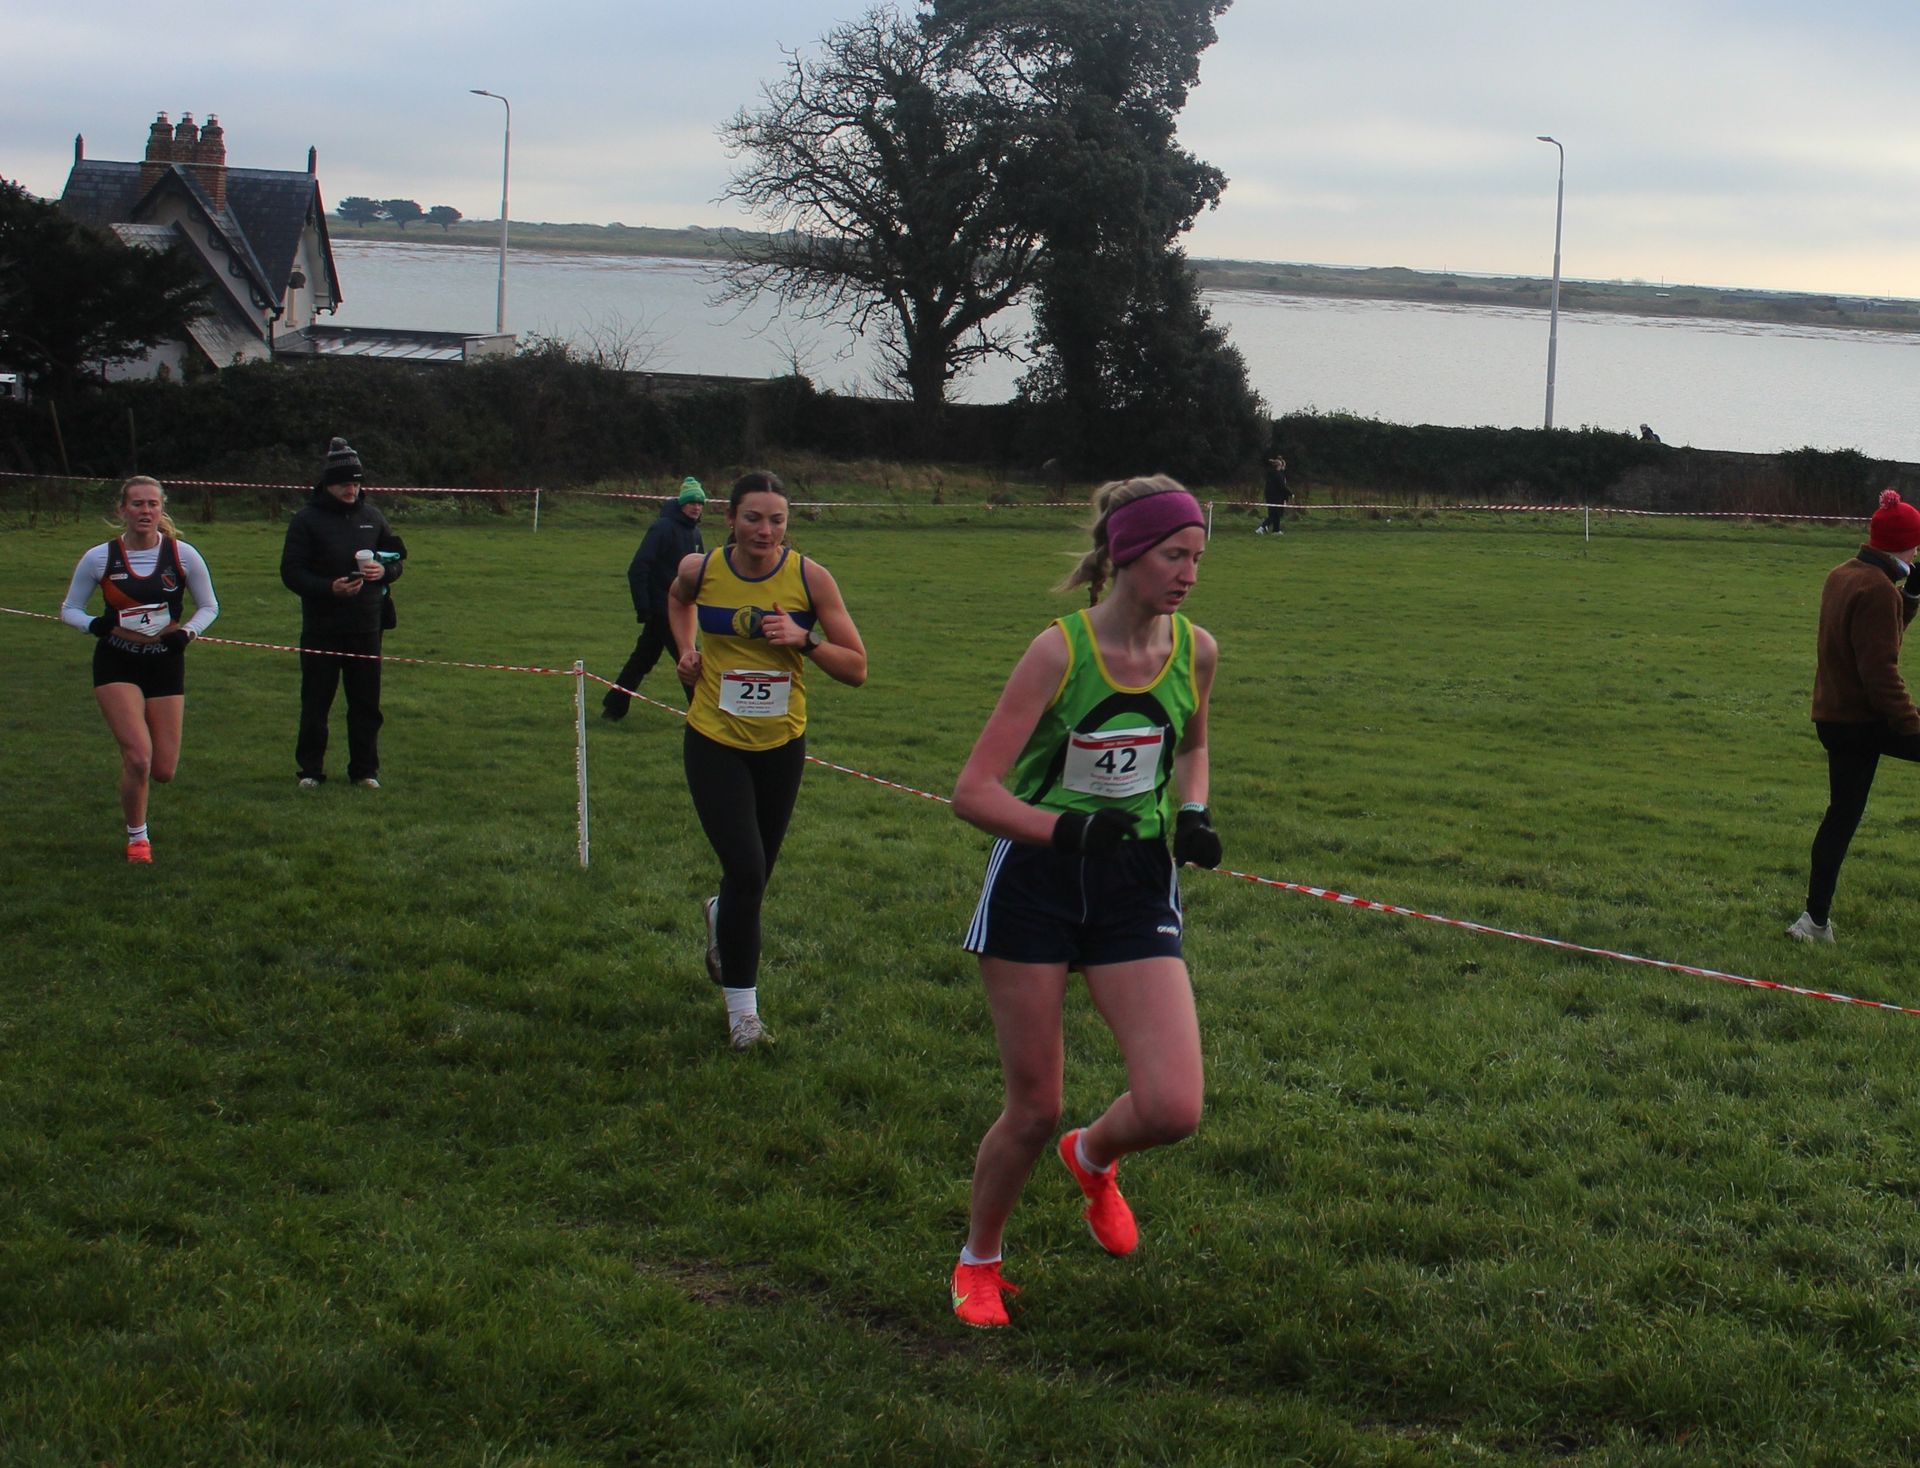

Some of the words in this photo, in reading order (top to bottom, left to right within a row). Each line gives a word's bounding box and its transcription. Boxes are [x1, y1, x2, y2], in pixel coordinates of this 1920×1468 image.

[140, 613, 151, 625] 4
[108, 635, 140, 653] NIKE
[740, 682, 771, 700] 25
[1094, 747, 1137, 774] 42
